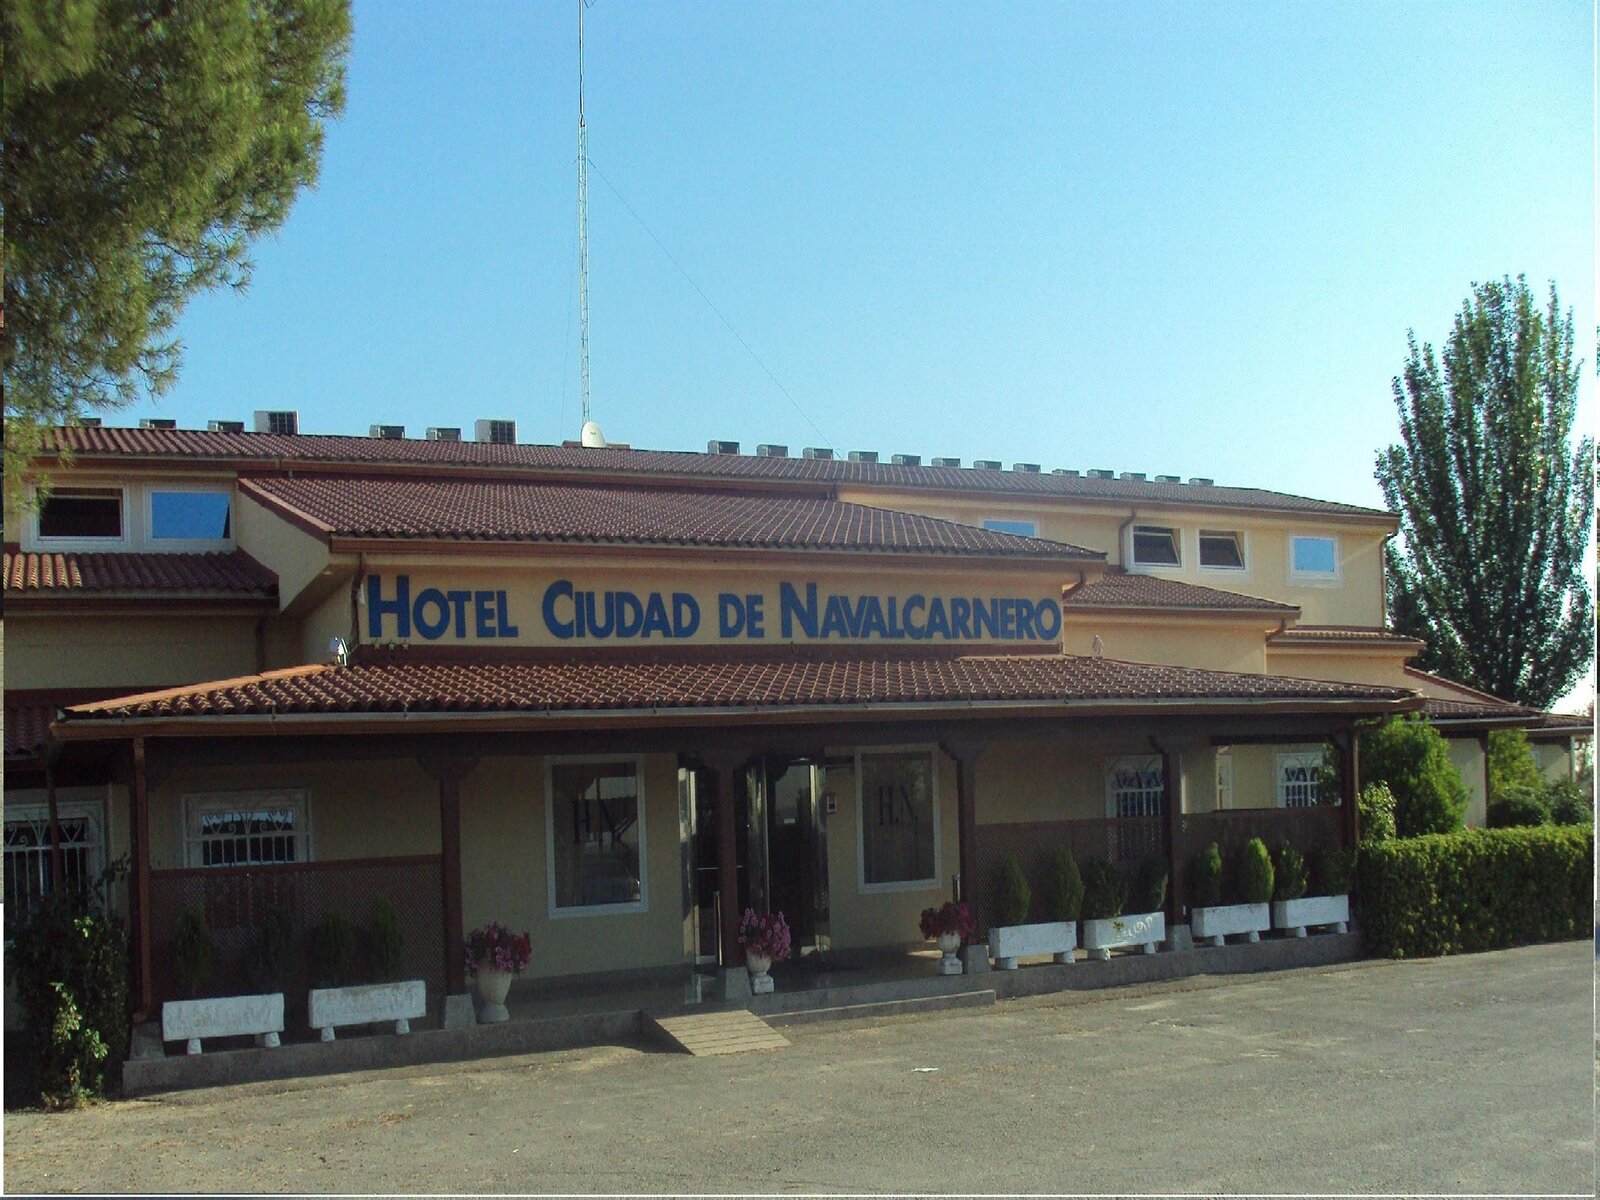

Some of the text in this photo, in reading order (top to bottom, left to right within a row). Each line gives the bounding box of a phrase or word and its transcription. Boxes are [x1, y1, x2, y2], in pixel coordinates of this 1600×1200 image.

[368, 574, 1062, 641] HOTEL CIUDAD DE NAVALCARNERO
